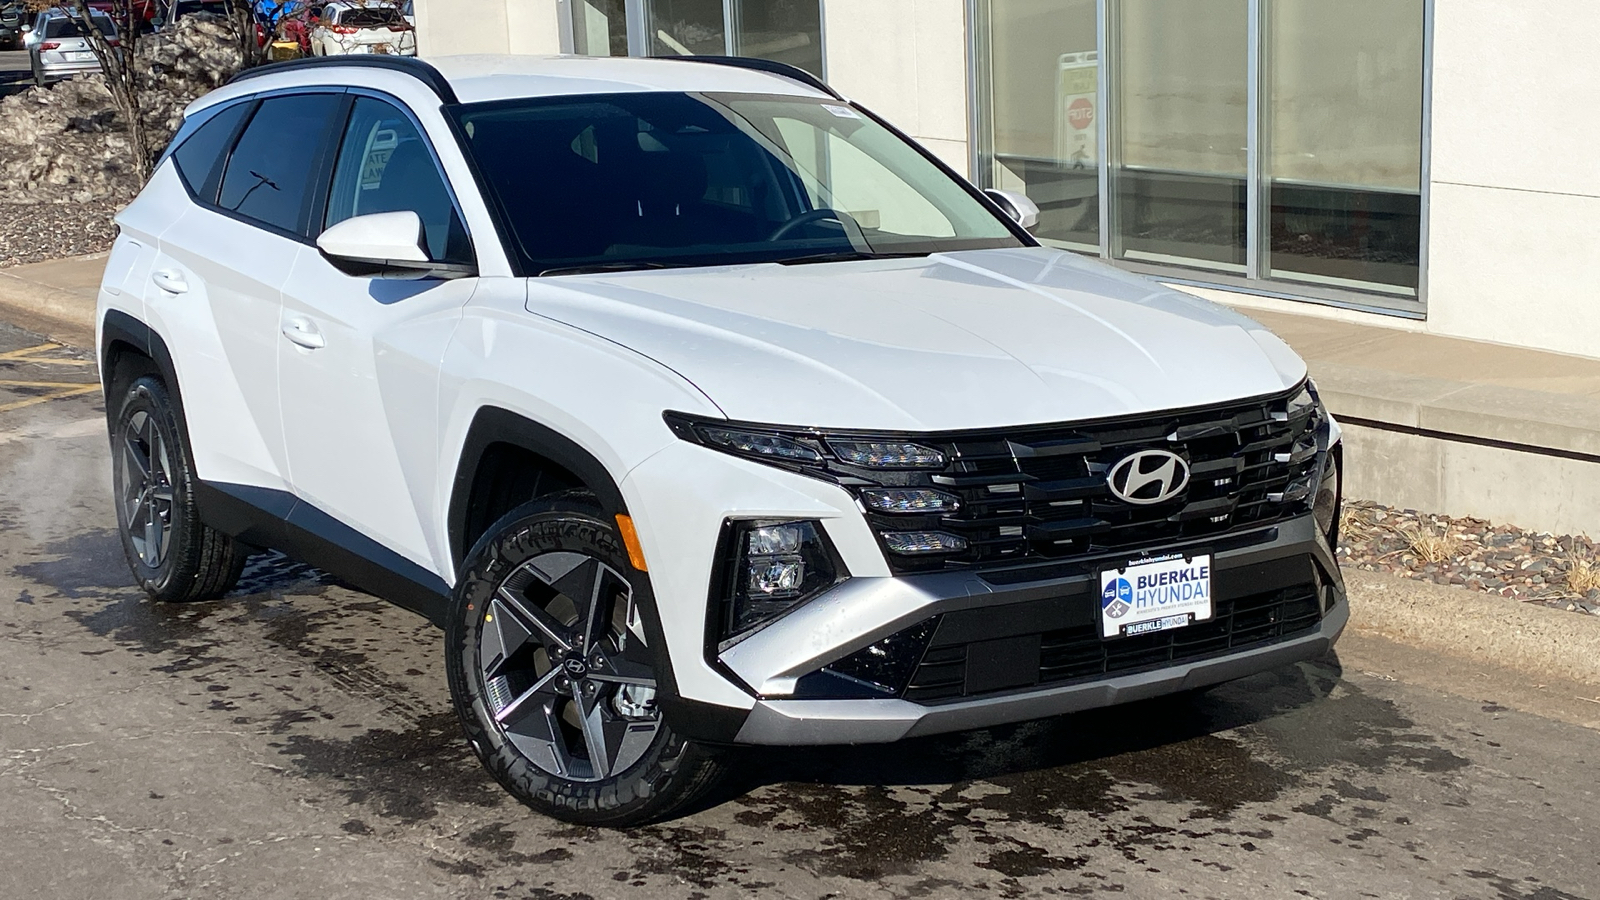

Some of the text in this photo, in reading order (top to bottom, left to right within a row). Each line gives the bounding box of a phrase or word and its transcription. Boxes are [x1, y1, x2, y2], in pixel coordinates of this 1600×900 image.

[1137, 566, 1209, 590] BUERKLE
[1136, 580, 1209, 608] HYUNDAI
[1127, 614, 1187, 634] BUERKLE HYUNDAI
